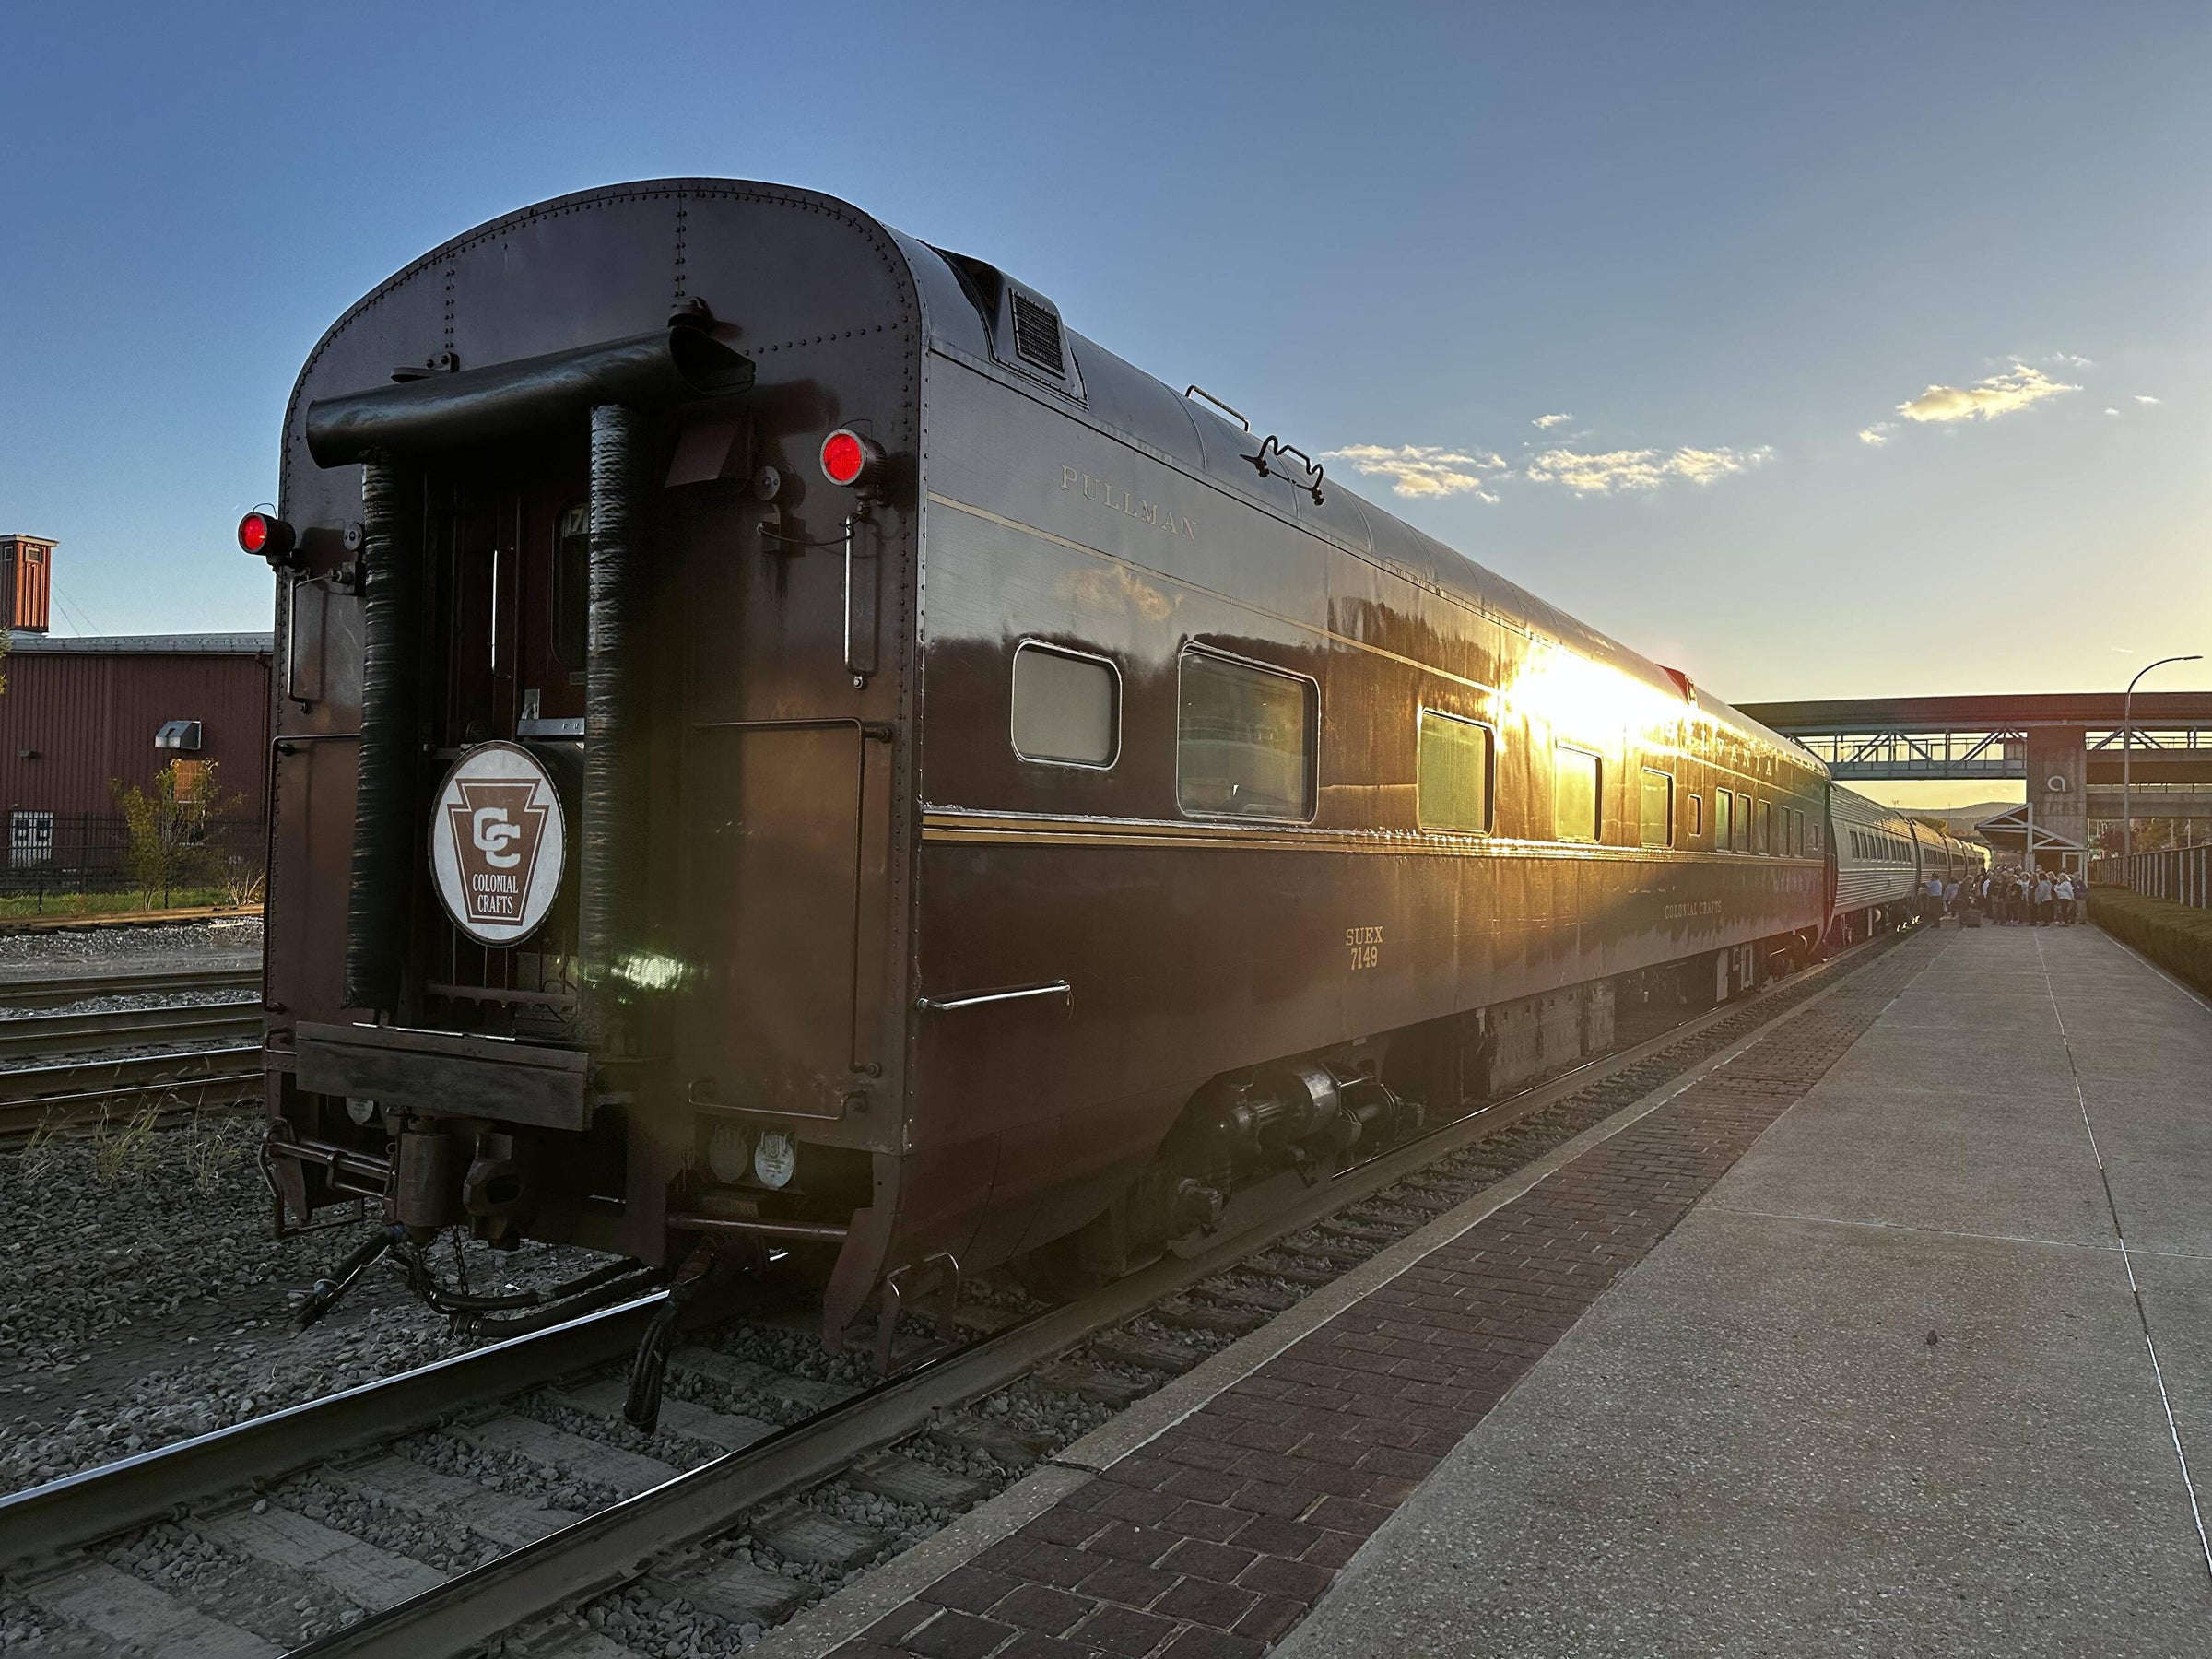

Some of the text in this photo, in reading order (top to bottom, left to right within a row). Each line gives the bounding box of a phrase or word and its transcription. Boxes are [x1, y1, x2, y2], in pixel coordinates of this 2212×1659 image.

[1060, 464, 1197, 542] PULLMAN
[473, 806, 522, 868] CC
[472, 873, 519, 894] COLONIAL
[477, 894, 513, 914] CRAFTS
[1665, 900, 1723, 920] COLONIAL CRAFTS
[1345, 926, 1384, 946] SUEX
[1350, 946, 1379, 971] 7149
